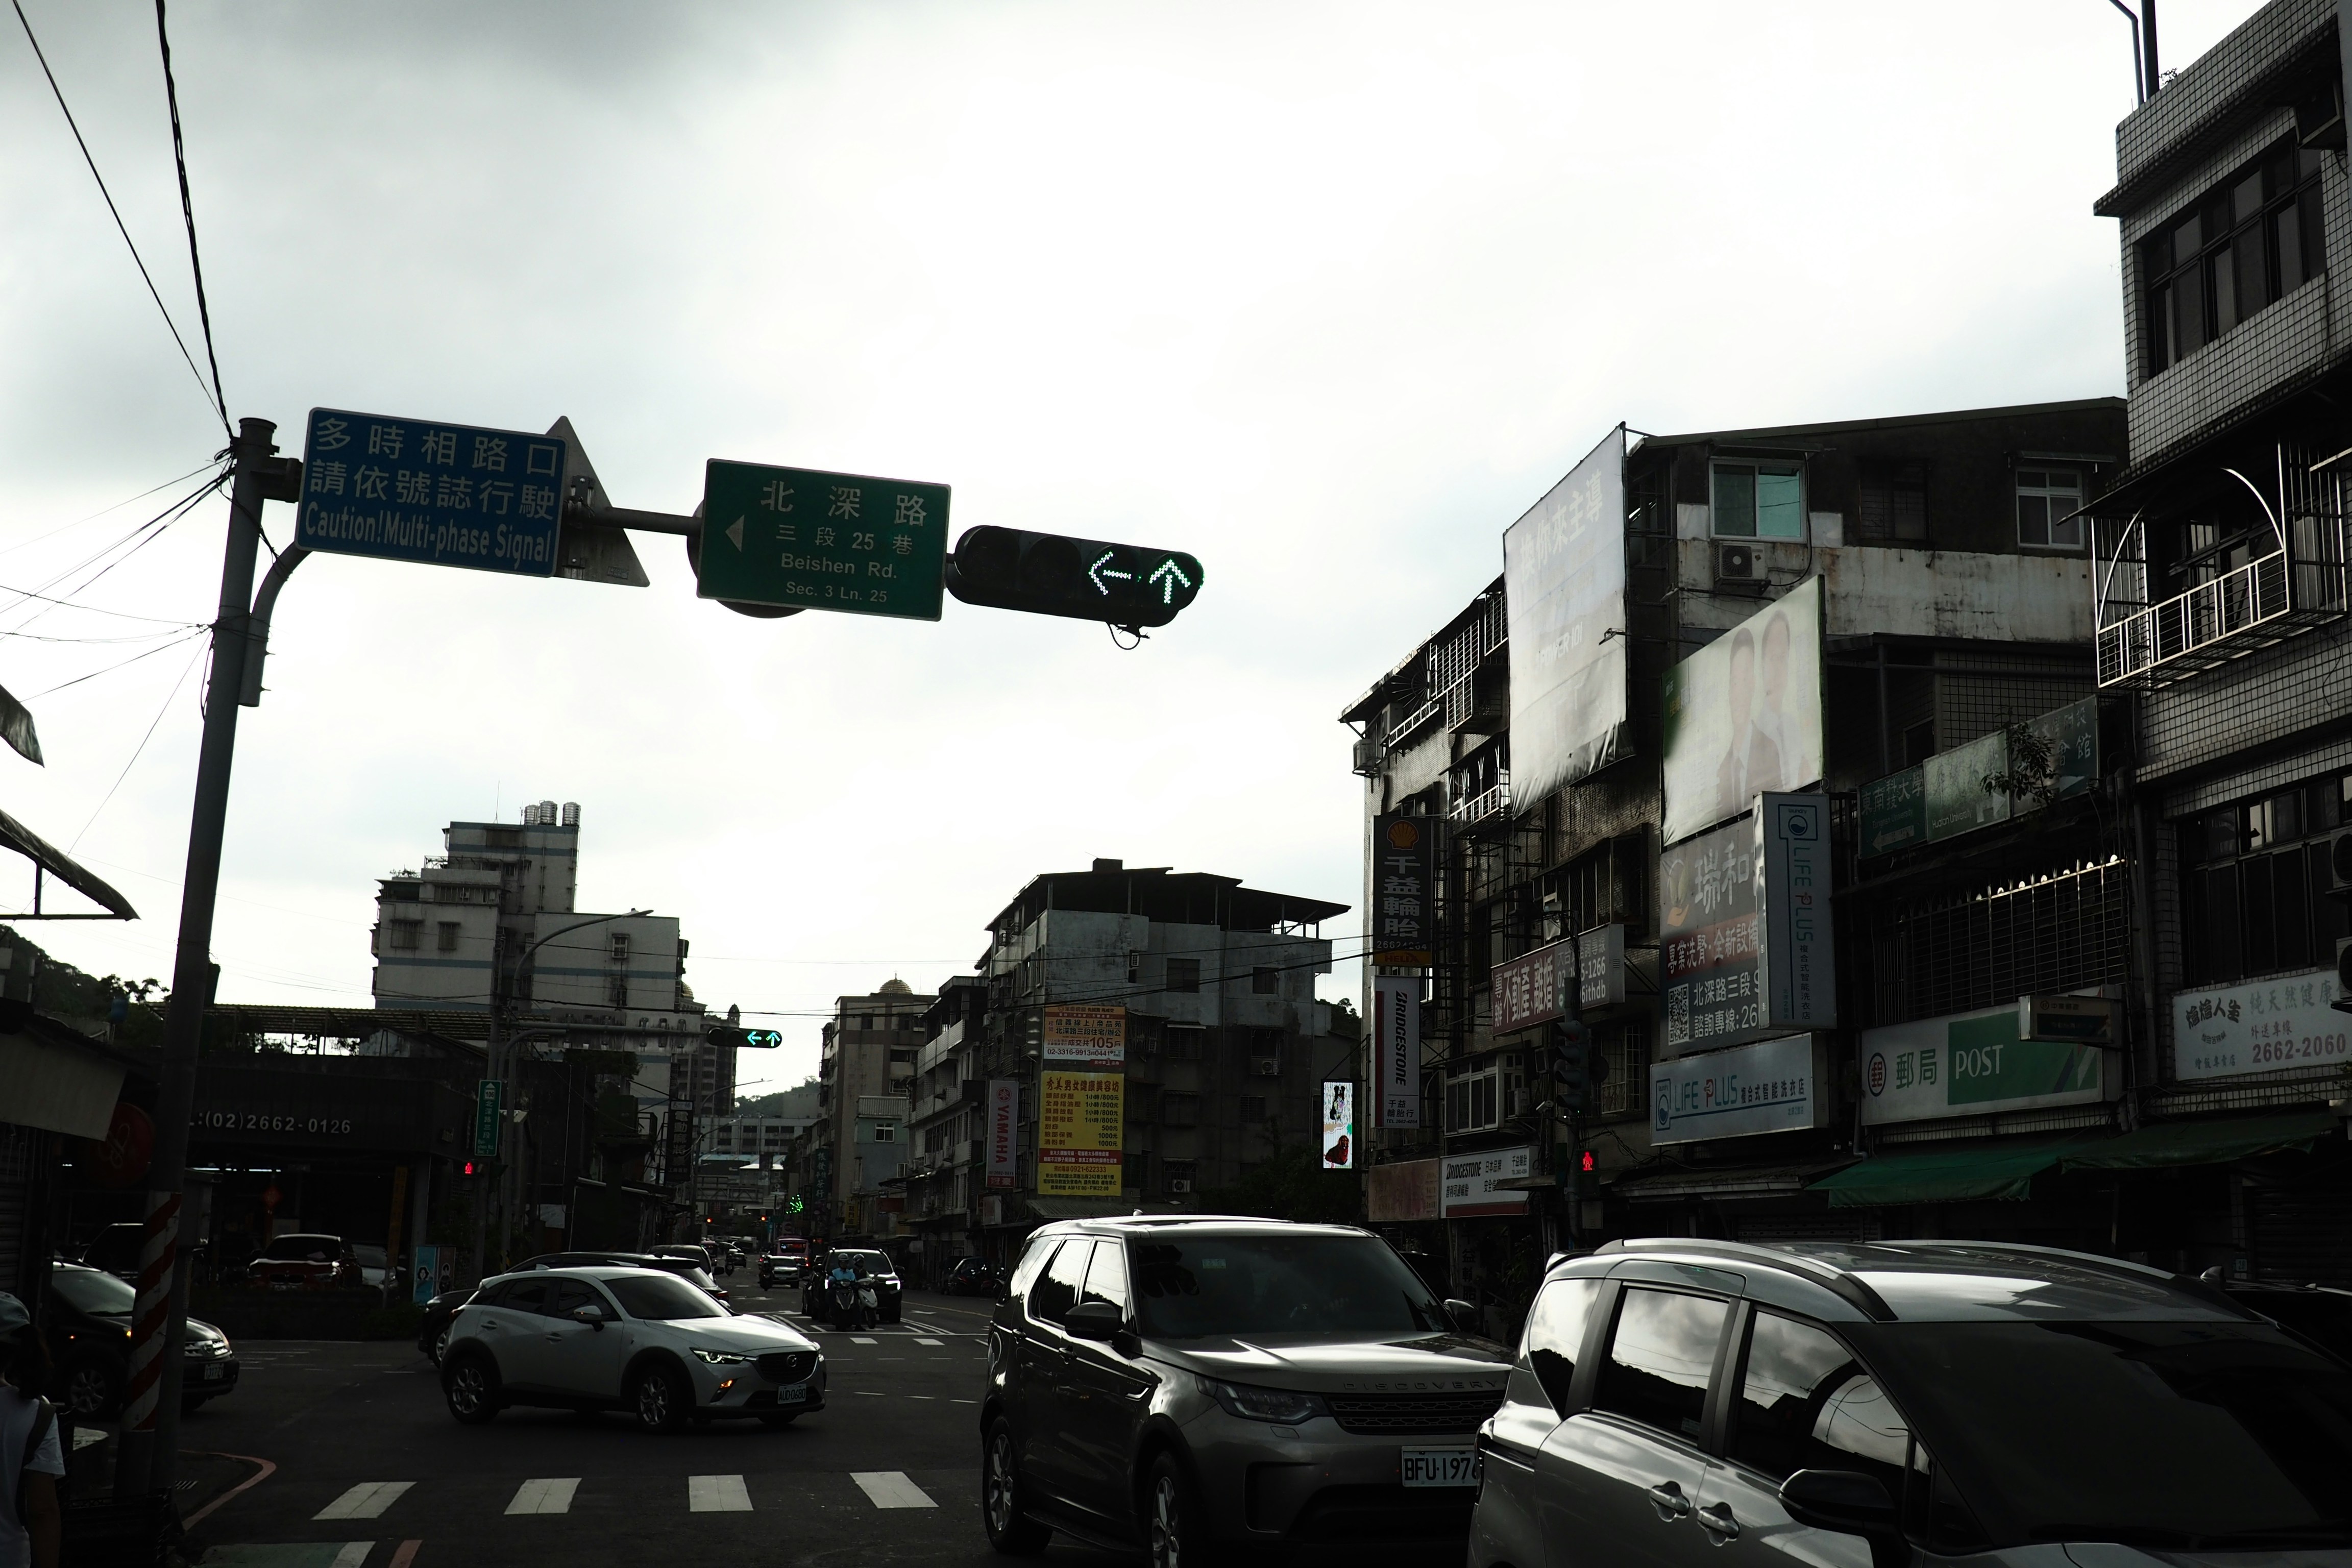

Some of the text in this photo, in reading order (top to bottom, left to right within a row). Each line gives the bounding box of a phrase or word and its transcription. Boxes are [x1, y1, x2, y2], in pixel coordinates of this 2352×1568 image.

[315, 418, 557, 477] 多時相路口
[310, 459, 555, 521] 請依號誌行駛
[761, 480, 927, 527] 北深路
[495, 524, 552, 568] Signal
[781, 553, 897, 579] Beishen Rd.
[786, 581, 887, 602] Sec. 3 Ln. 25
[1383, 855, 1421, 938] 千益輪胎
[1794, 847, 1813, 941] LIFE PLUS
[1384, 953, 1419, 963] HELIX
[1694, 971, 1751, 1007] 北深路三段
[1800, 945, 1811, 1019] 複合式智能洗衣店
[1395, 990, 1408, 1086] BRIDGESTONE
[2252, 1033, 2346, 1063] 2662-2060
[1896, 1048, 1937, 1089] 郵局
[1955, 1044, 2004, 1080] POST
[1046, 1076, 1119, 1092] 秀美男女健康美容坊
[1675, 1075, 1737, 1112] LIFE PLUS
[1741, 1077, 1804, 1104] 複合式智能洗衣店
[482, 1100, 494, 1139] 北深路三段
[1387, 1109, 1414, 1118] 輪胎行
[1388, 1099, 1406, 1108] 千益
[189, 1110, 351, 1134] :(02)2662-0126
[996, 1105, 1009, 1163] YAMAHA
[1446, 1161, 1481, 1180] BRIDGESTONE
[1485, 1160, 1502, 1173] 日本品牌
[1343, 1380, 1498, 1390] DISCOVERY
